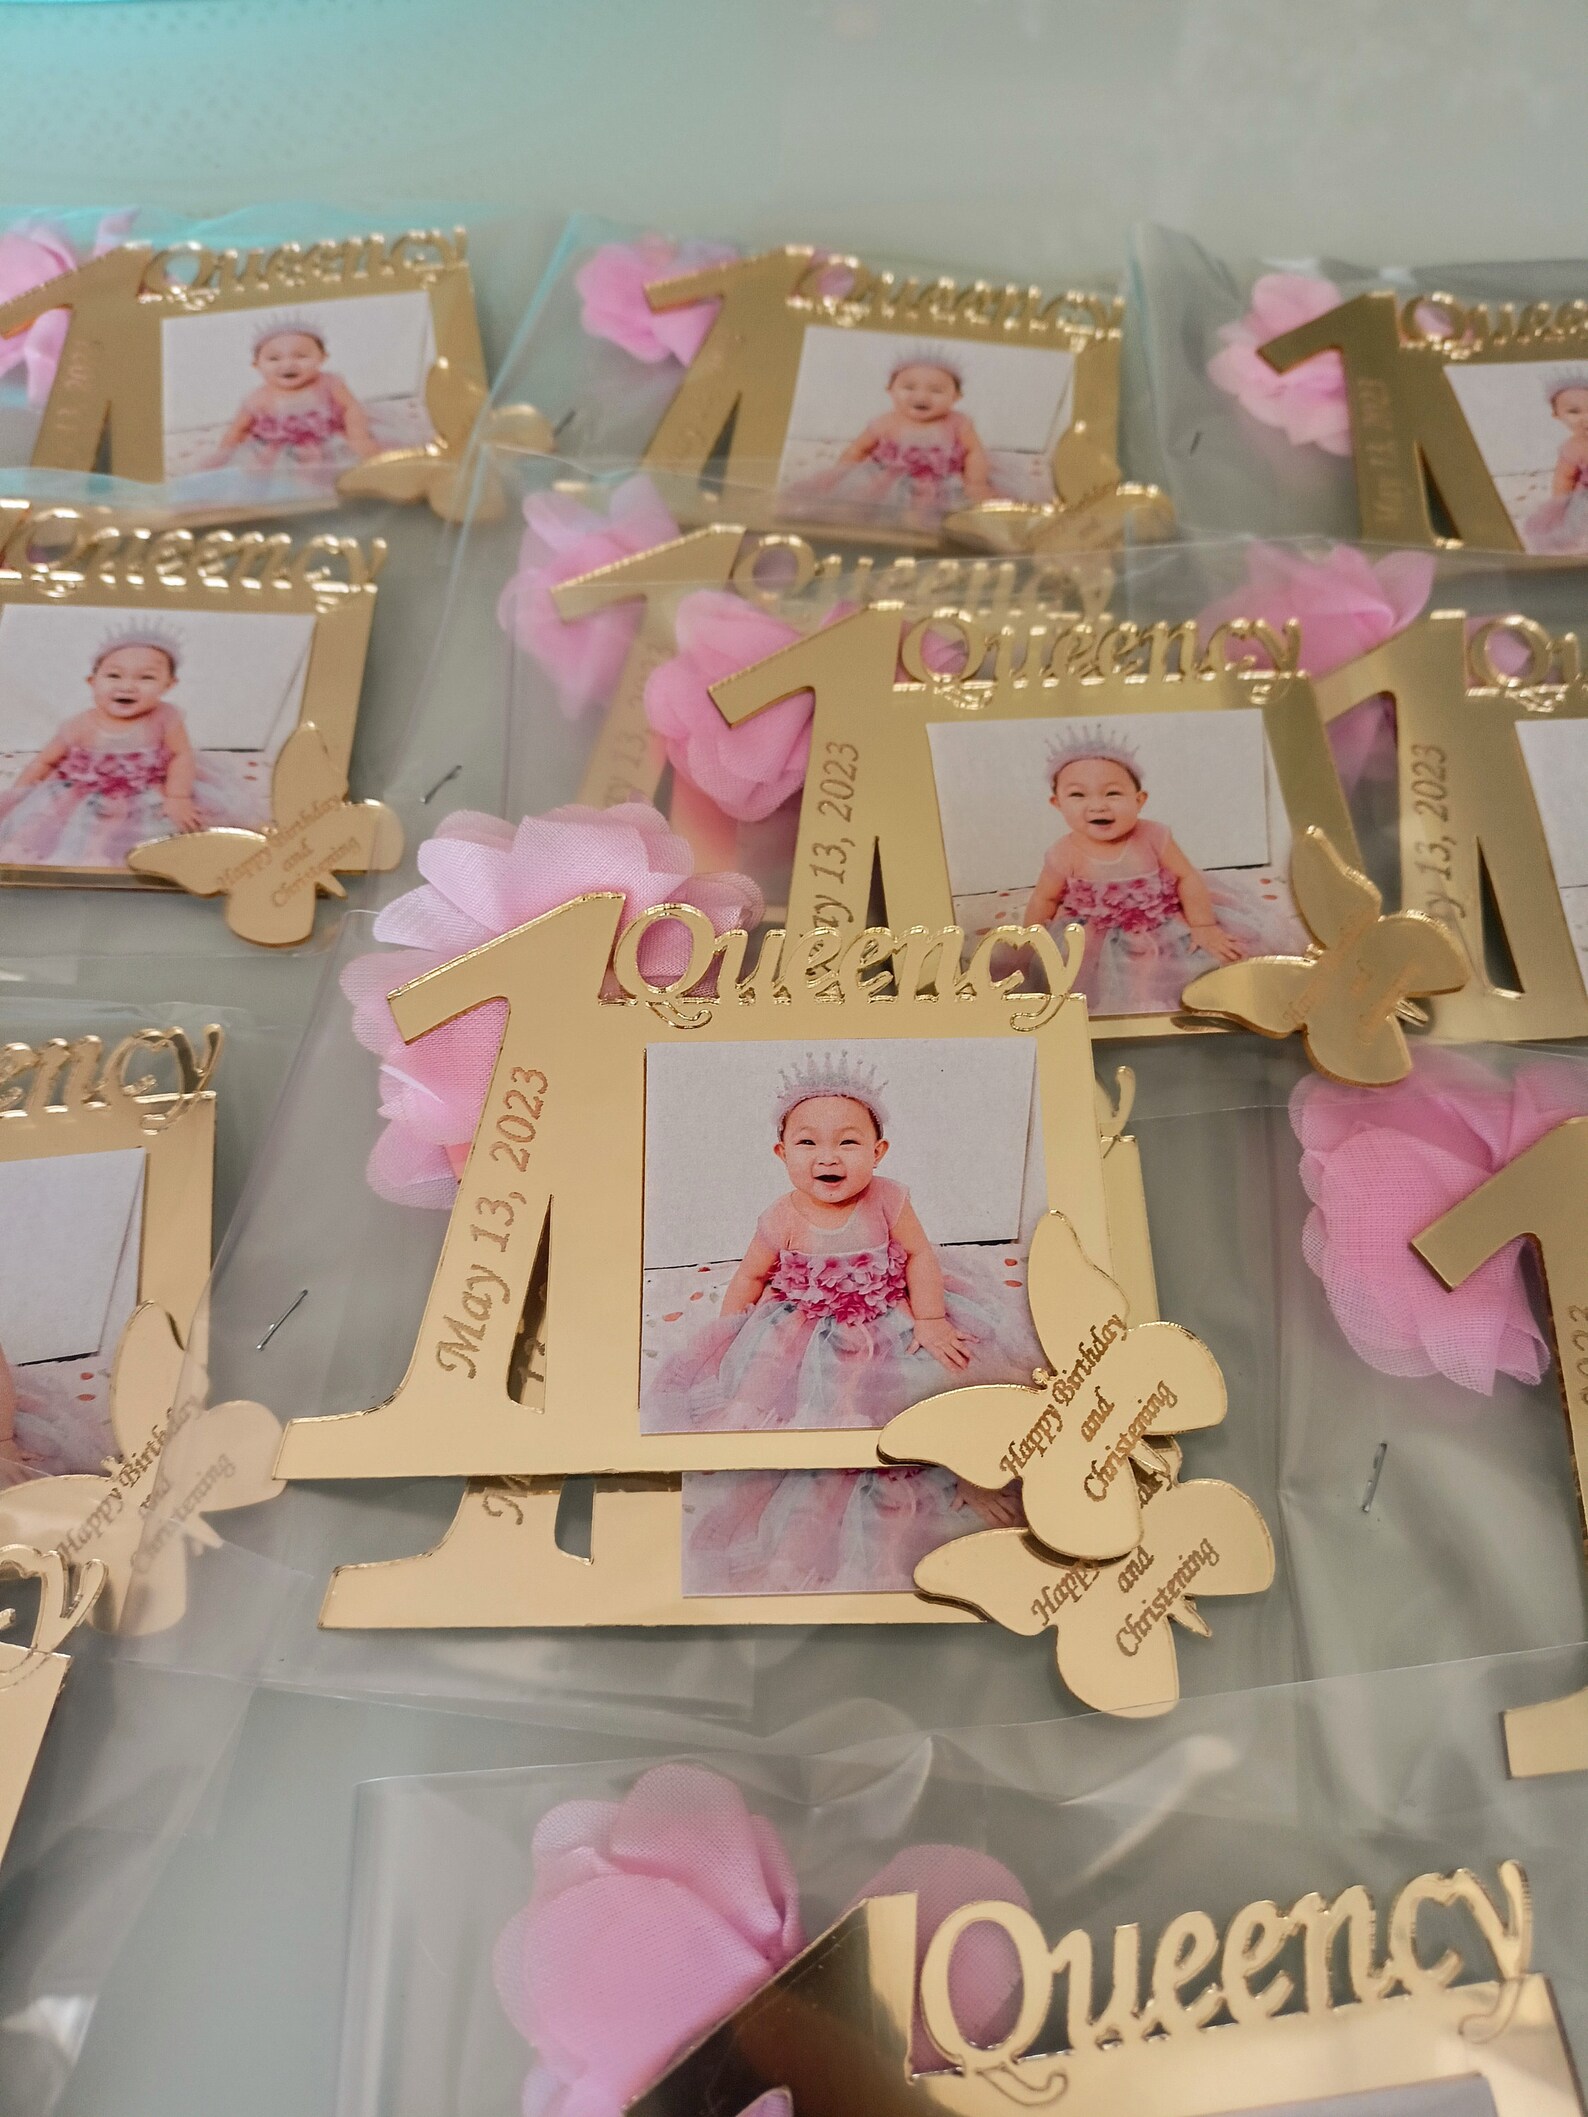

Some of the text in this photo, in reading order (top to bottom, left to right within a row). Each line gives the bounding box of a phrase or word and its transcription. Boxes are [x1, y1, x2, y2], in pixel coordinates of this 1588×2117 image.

[140, 226, 468, 311] Queency
[12, 508, 388, 614] Queency
[902, 608, 1300, 711] Queency
[817, 741, 859, 823] 2023
[1411, 744, 1450, 823] 2023
[809, 837, 856, 885] 13,
[613, 902, 1087, 1033] Queency
[434, 1066, 549, 1380] May 13, 2023
[999, 1313, 1129, 1477] Happy Birthday
[1080, 1385, 1115, 1443] and
[1083, 1380, 1179, 1503] Christening
[1115, 1537, 1221, 1658] Christening
[1117, 1545, 1155, 1594] and
[917, 1858, 1533, 2105] Queency
